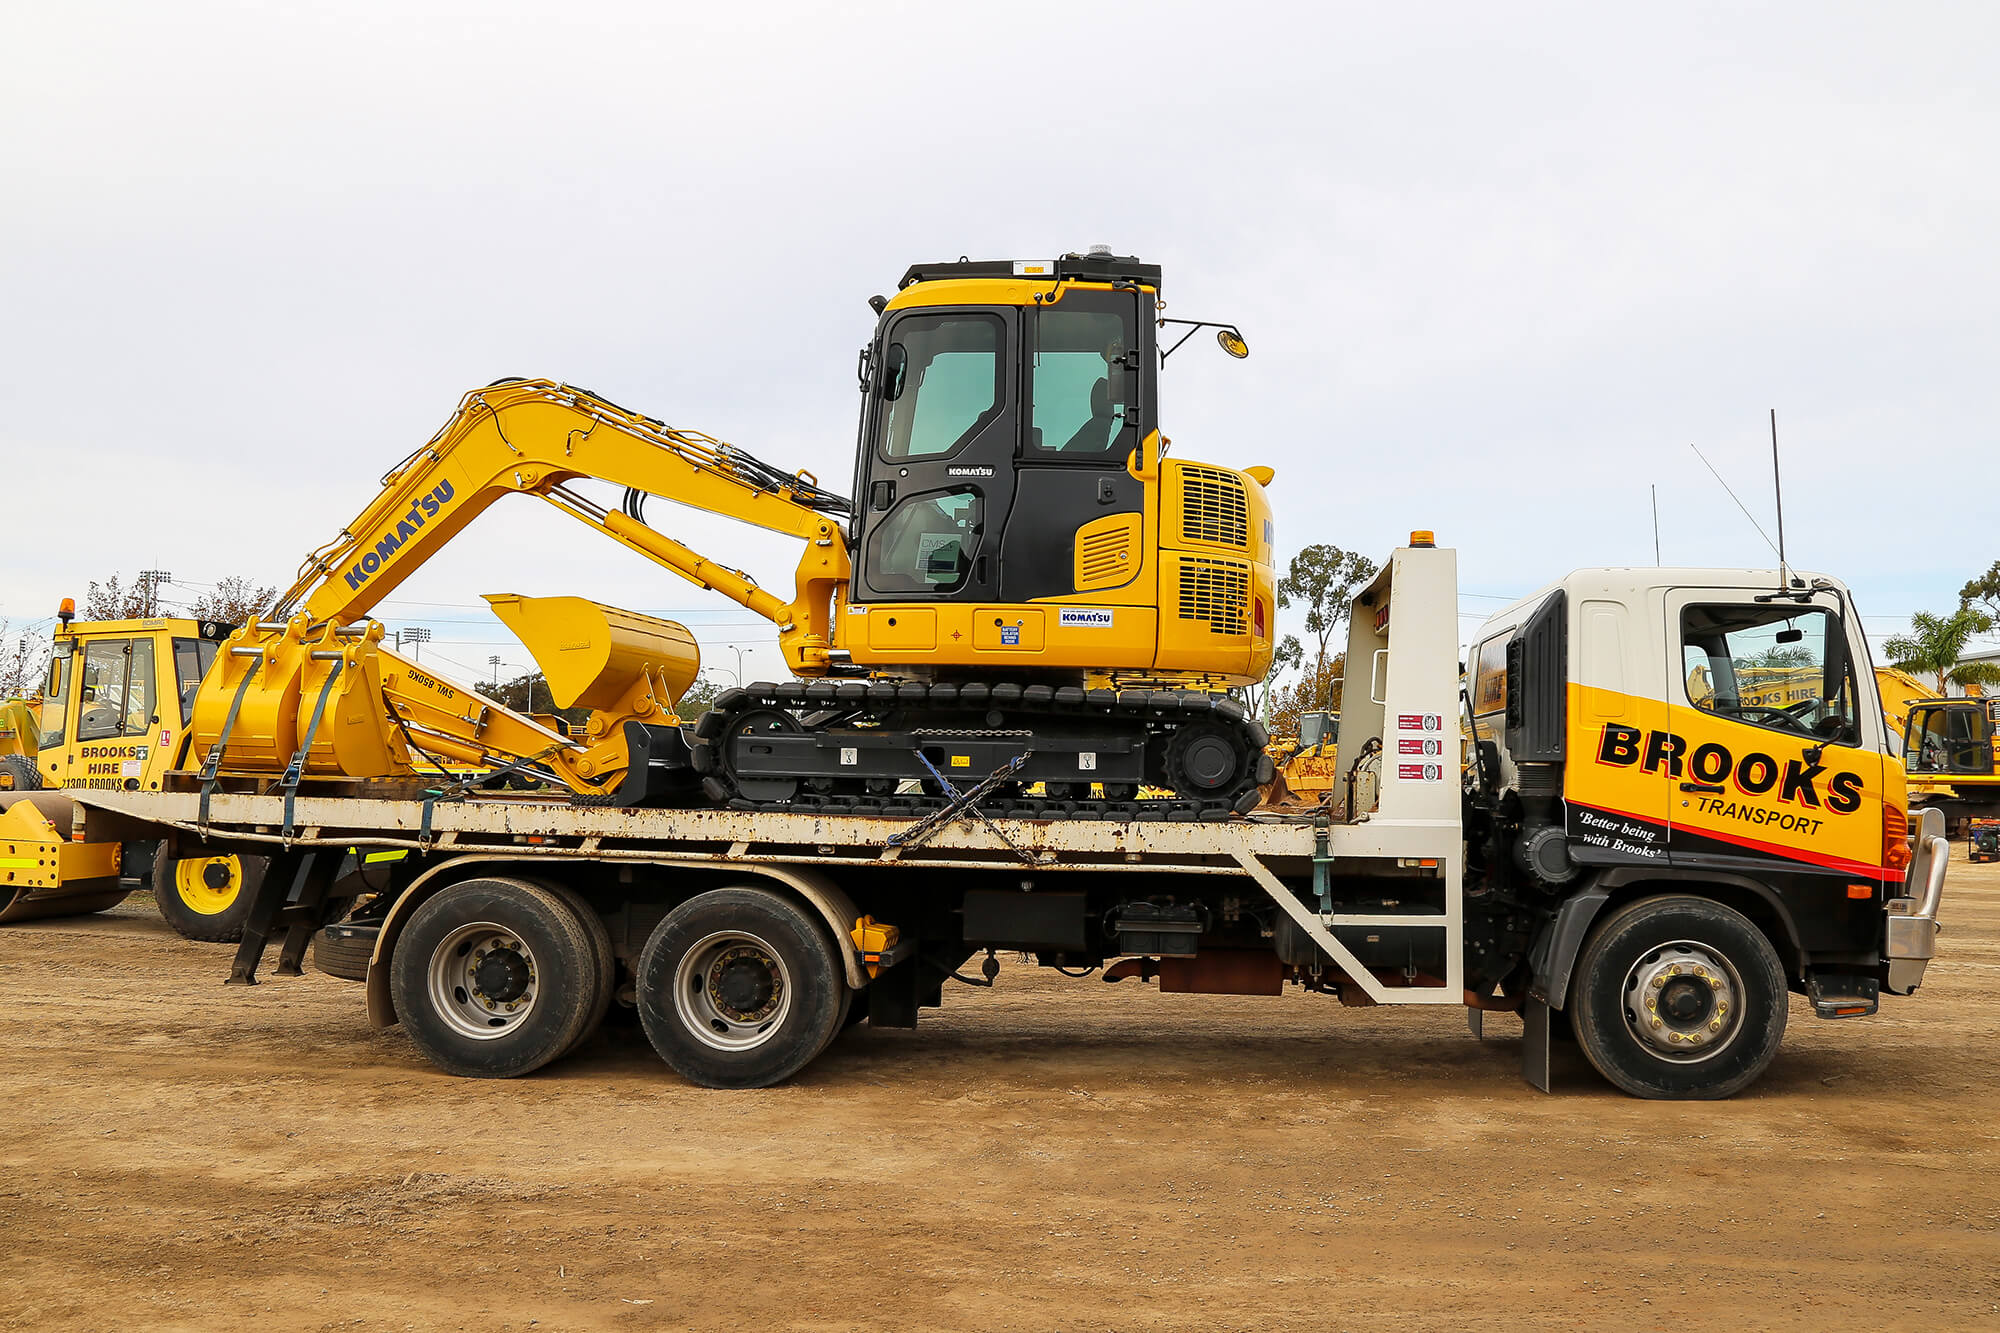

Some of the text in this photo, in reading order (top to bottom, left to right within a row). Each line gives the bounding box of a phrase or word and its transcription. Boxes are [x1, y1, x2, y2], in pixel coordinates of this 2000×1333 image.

[948, 466, 993, 476] KOMATSU
[343, 478, 455, 591] KOMATSU
[1062, 612, 1110, 622] KOMATSU
[408, 669, 455, 699] SWL 850KG
[1786, 687, 1816, 701] HIRE
[81, 746, 136, 758] BROOKS
[88, 763, 119, 774] HIRE
[1595, 722, 1865, 815] BROOKS
[1698, 797, 1824, 836] TRANSPORT
[1621, 822, 1656, 843] being
[1583, 833, 1610, 847] with
